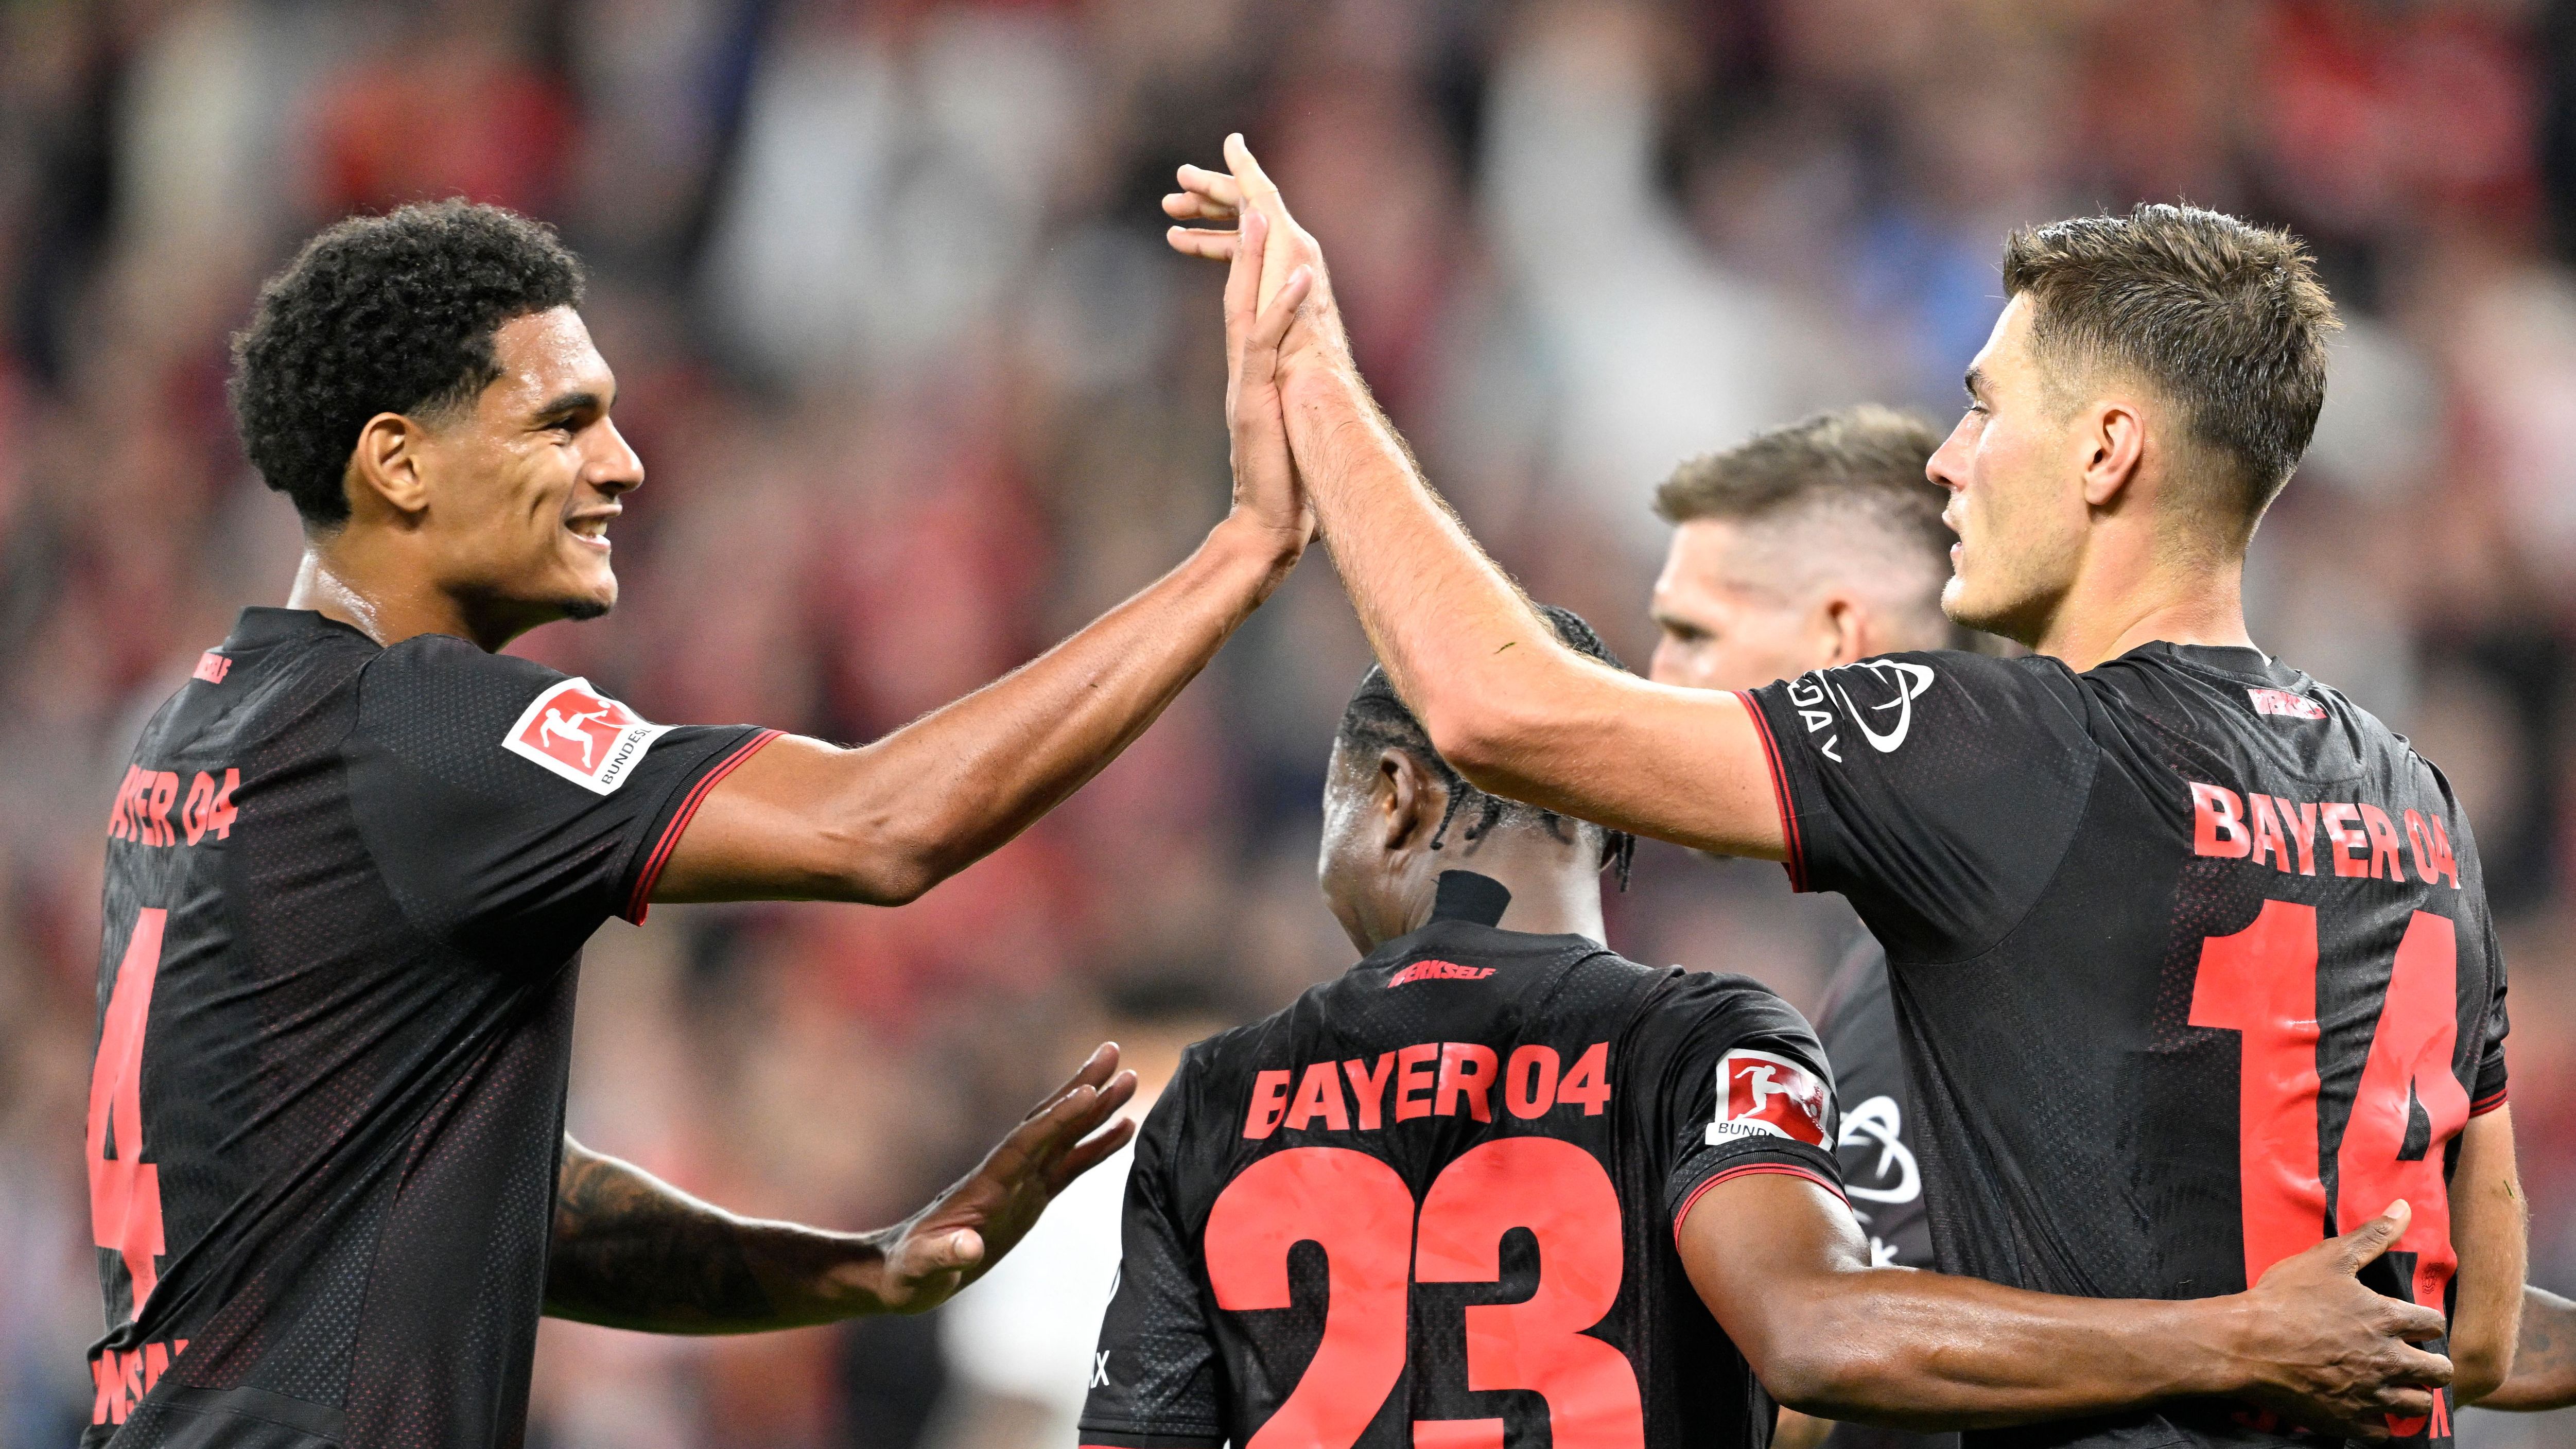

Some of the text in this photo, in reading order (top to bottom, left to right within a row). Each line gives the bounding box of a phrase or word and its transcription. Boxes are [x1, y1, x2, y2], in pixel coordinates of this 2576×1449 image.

[182, 768, 240, 846] 04
[2189, 781, 2461, 889] BAYER 04
[85, 907, 167, 1322] 4
[1243, 1041, 1611, 1140] BAYER 04
[2187, 898, 2470, 1322] 14
[1204, 1136, 1645, 1449] 23
